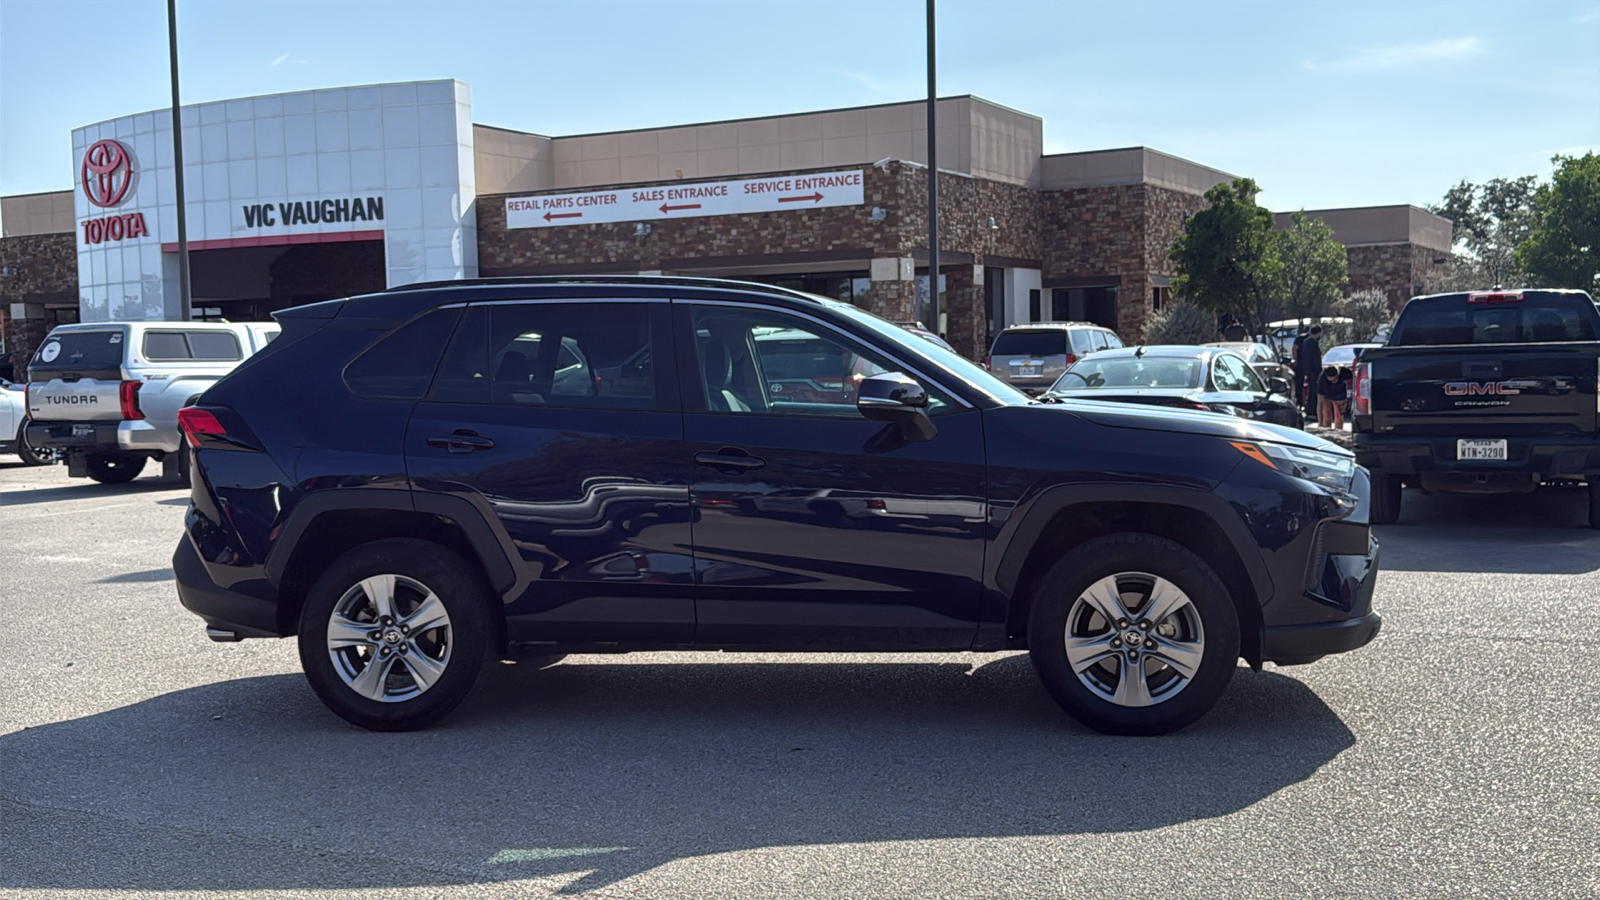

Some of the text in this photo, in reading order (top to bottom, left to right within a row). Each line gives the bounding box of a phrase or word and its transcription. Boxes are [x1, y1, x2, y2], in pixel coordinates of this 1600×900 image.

[744, 174, 861, 194] SERVICE ENTRANCE
[508, 194, 617, 211] RETAIL PARTS CENTER
[632, 185, 728, 203] SALES ENTRANCE
[243, 197, 384, 228] VIC VAUGHAN
[81, 212, 148, 245] TOYOTA
[1443, 382, 1520, 396] GMC
[46, 395, 98, 405] TUNDRA
